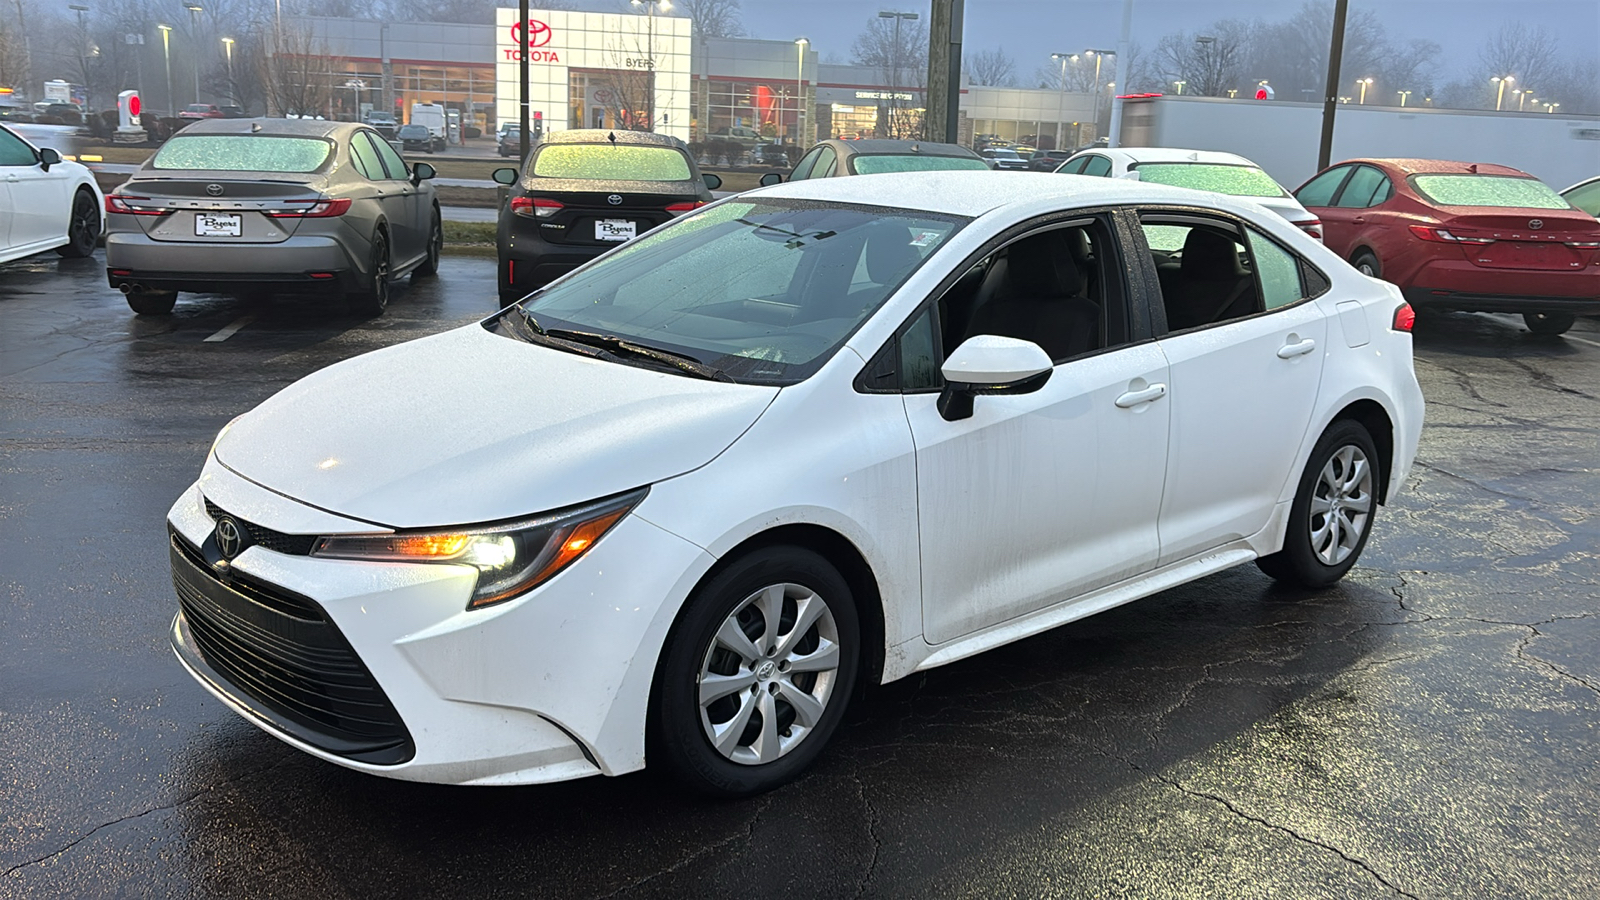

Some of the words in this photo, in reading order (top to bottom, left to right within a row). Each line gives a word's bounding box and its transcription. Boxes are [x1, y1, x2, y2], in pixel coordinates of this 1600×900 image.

[503, 49, 559, 62] TOOTA
[625, 57, 655, 68] BYERS
[855, 91, 880, 99] SERVICE
[880, 92, 913, 101] RECPTION
[200, 217, 237, 230] Byers
[598, 222, 633, 235] Byers
